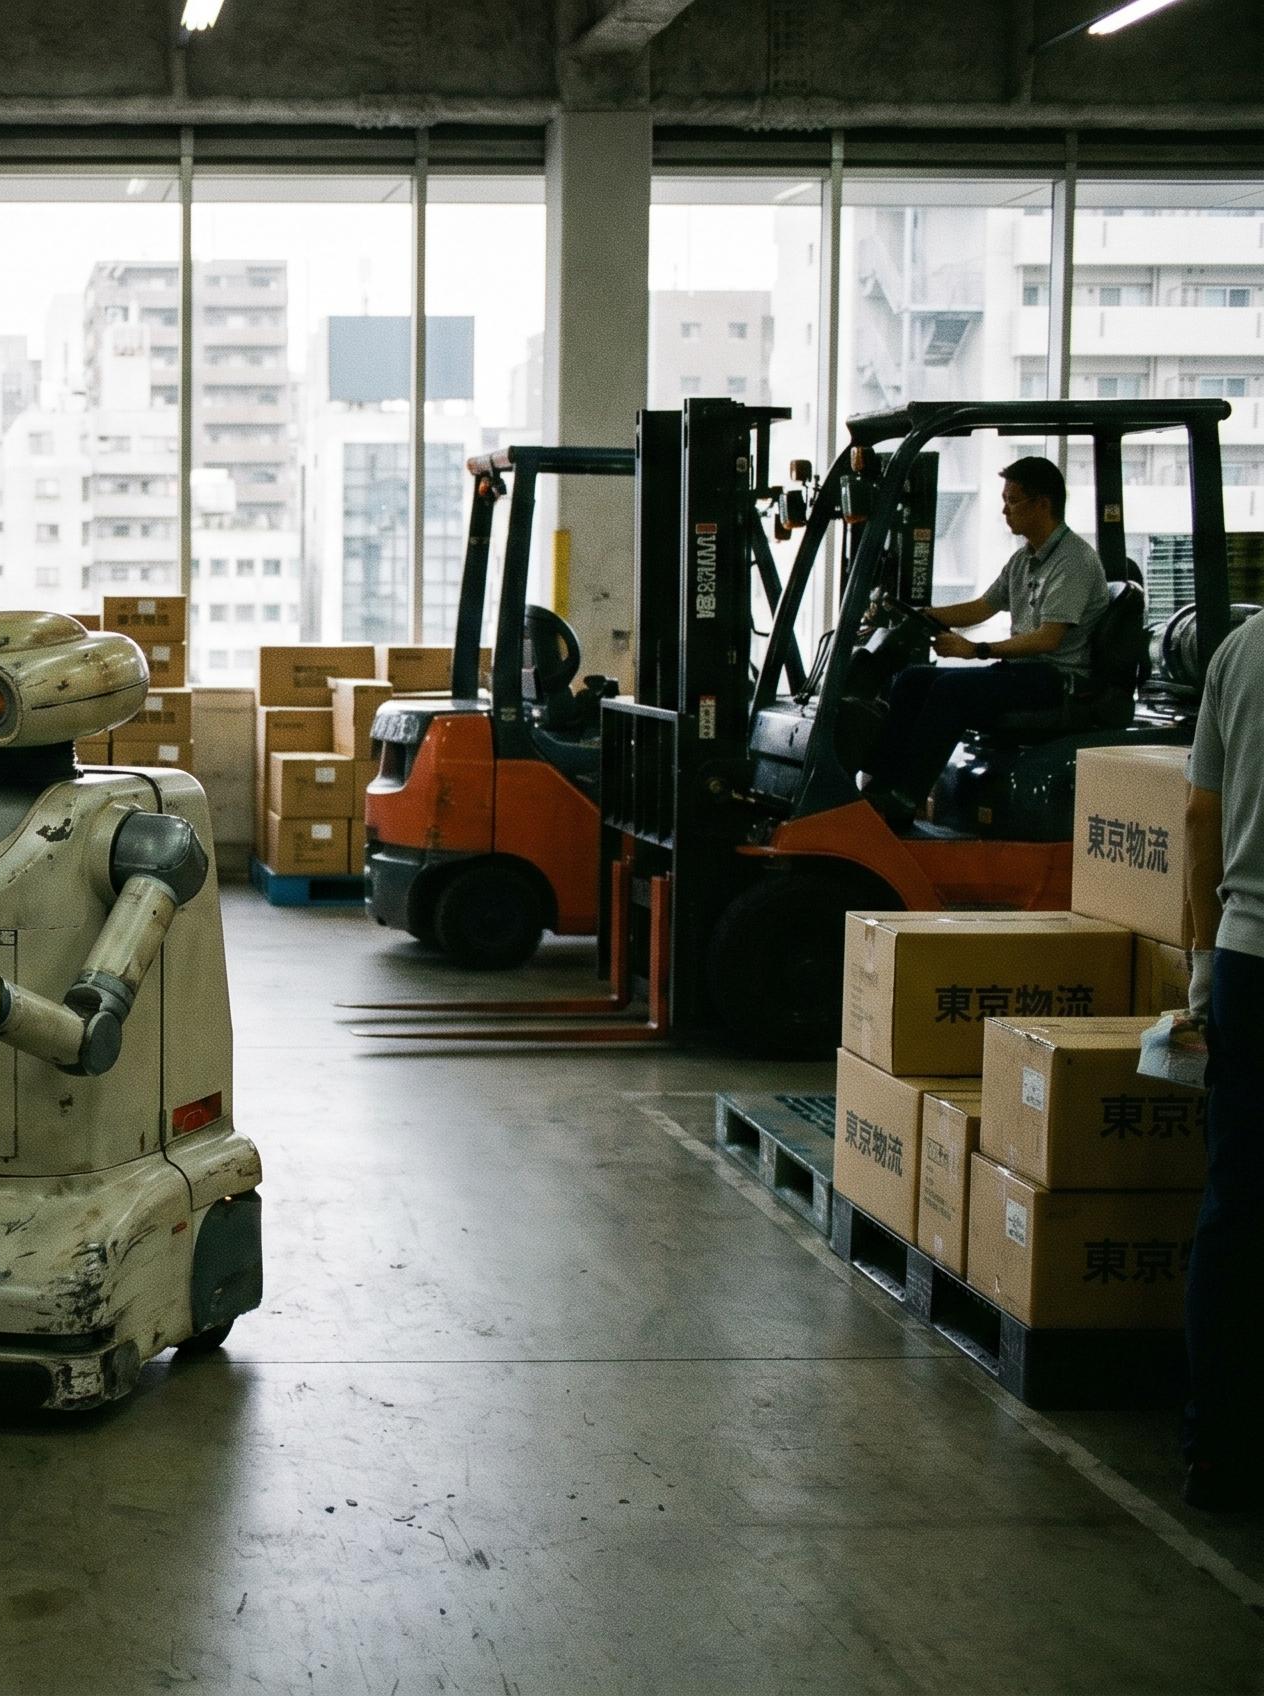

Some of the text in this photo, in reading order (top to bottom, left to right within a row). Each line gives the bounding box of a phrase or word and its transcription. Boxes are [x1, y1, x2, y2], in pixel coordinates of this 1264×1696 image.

[1087, 814, 1169, 874] 東京物流
[935, 984, 1095, 1018] 東京物流
[845, 1110, 903, 1176] 東京物流
